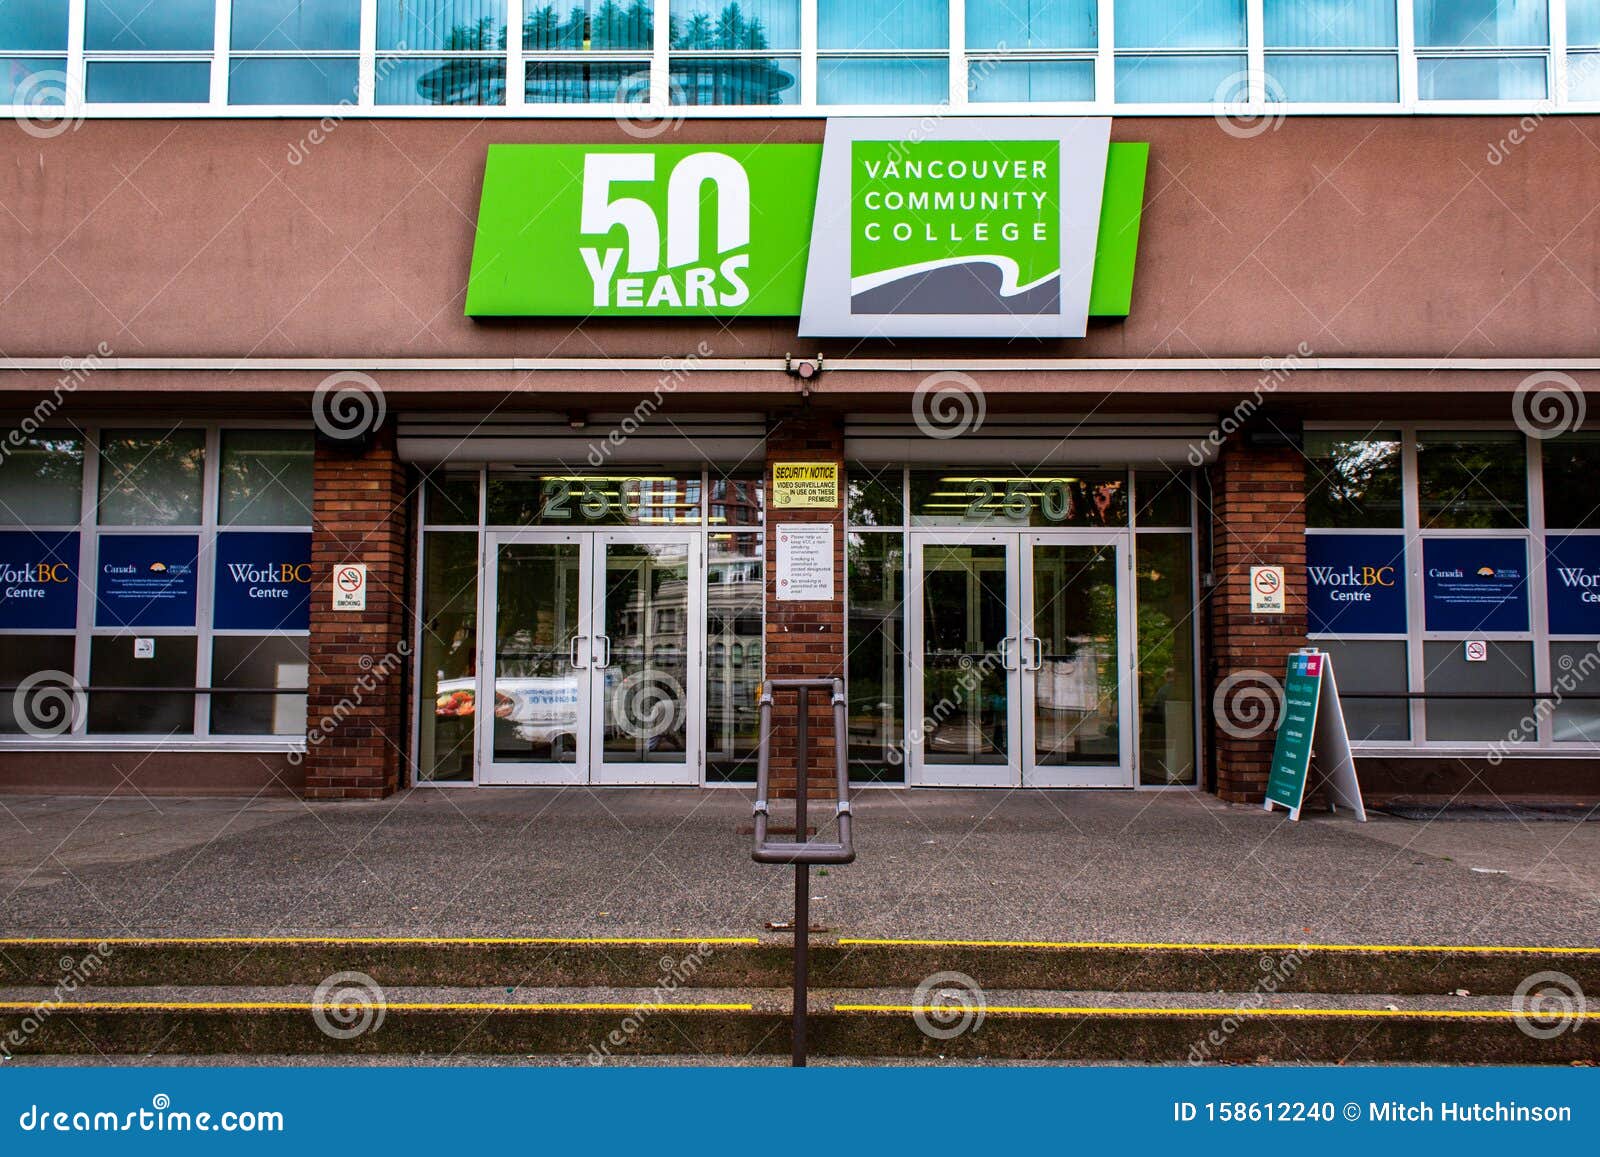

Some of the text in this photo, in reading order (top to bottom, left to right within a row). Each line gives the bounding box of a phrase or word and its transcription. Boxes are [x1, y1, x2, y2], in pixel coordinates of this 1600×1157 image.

[863, 160, 1048, 180] VANCOUVER
[864, 191, 1048, 211] COMMUNITY
[579, 152, 750, 272] 50
[864, 222, 1048, 242] COLLEGE
[579, 247, 750, 307] YEARS
[776, 467, 835, 479] SECURITY NOTICE
[542, 477, 646, 519] 250
[966, 479, 1073, 521] 250
[103, 564, 136, 574] Canada
[227, 563, 312, 583] WorkBC
[1306, 566, 1395, 587] WorkBC
[1429, 568, 1464, 578] Canada
[1557, 567, 1600, 587] Wor
[6, 586, 45, 598] Centre
[249, 587, 289, 598] Centre
[1330, 590, 1372, 601] Centre
